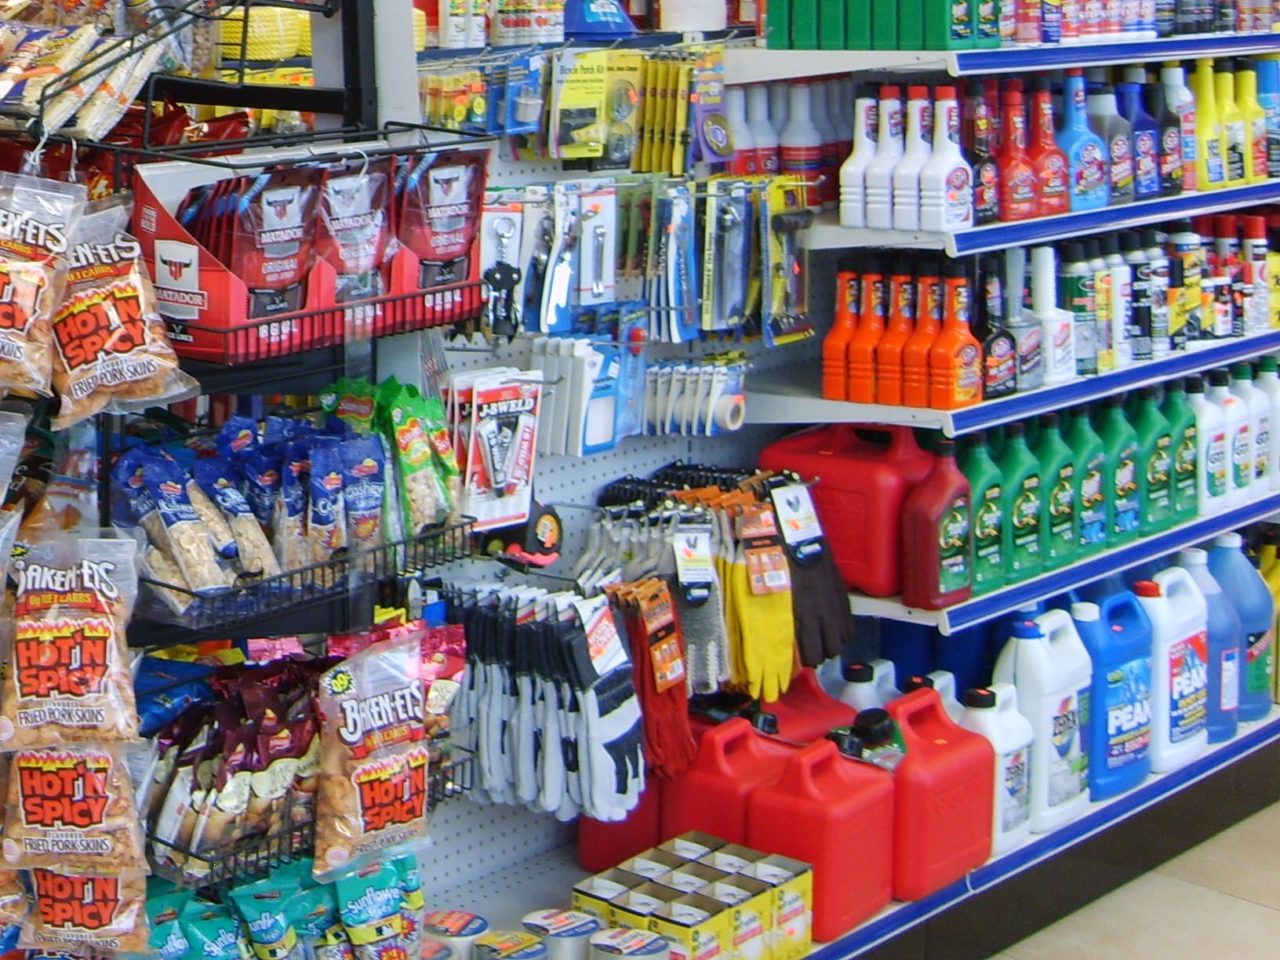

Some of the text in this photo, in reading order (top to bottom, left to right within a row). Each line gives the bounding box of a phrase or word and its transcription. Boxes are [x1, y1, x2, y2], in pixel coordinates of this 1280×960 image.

[18, 709, 48, 725] FRIED
[25, 795, 107, 828] SPICY
[24, 838, 109, 853] FRIED PORK SKINS
